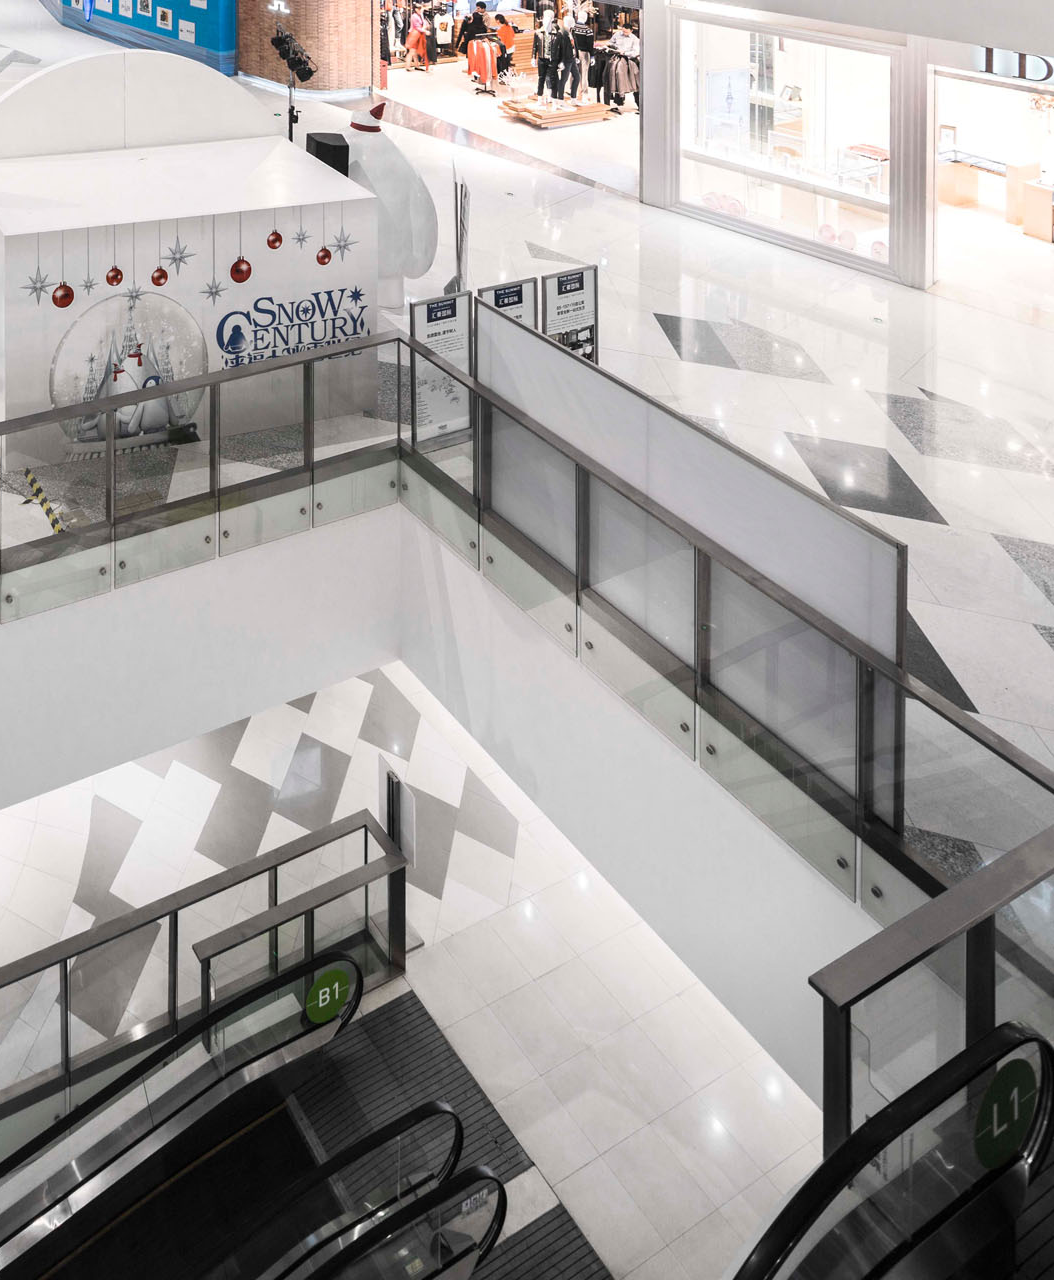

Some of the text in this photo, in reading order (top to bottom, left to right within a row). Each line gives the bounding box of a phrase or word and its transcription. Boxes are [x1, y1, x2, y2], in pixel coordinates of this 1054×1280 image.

[216, 305, 368, 355] CENTURY
[252, 288, 348, 328] SNOW
[318, 981, 339, 1008] B1
[993, 1086, 1019, 1138] L1
